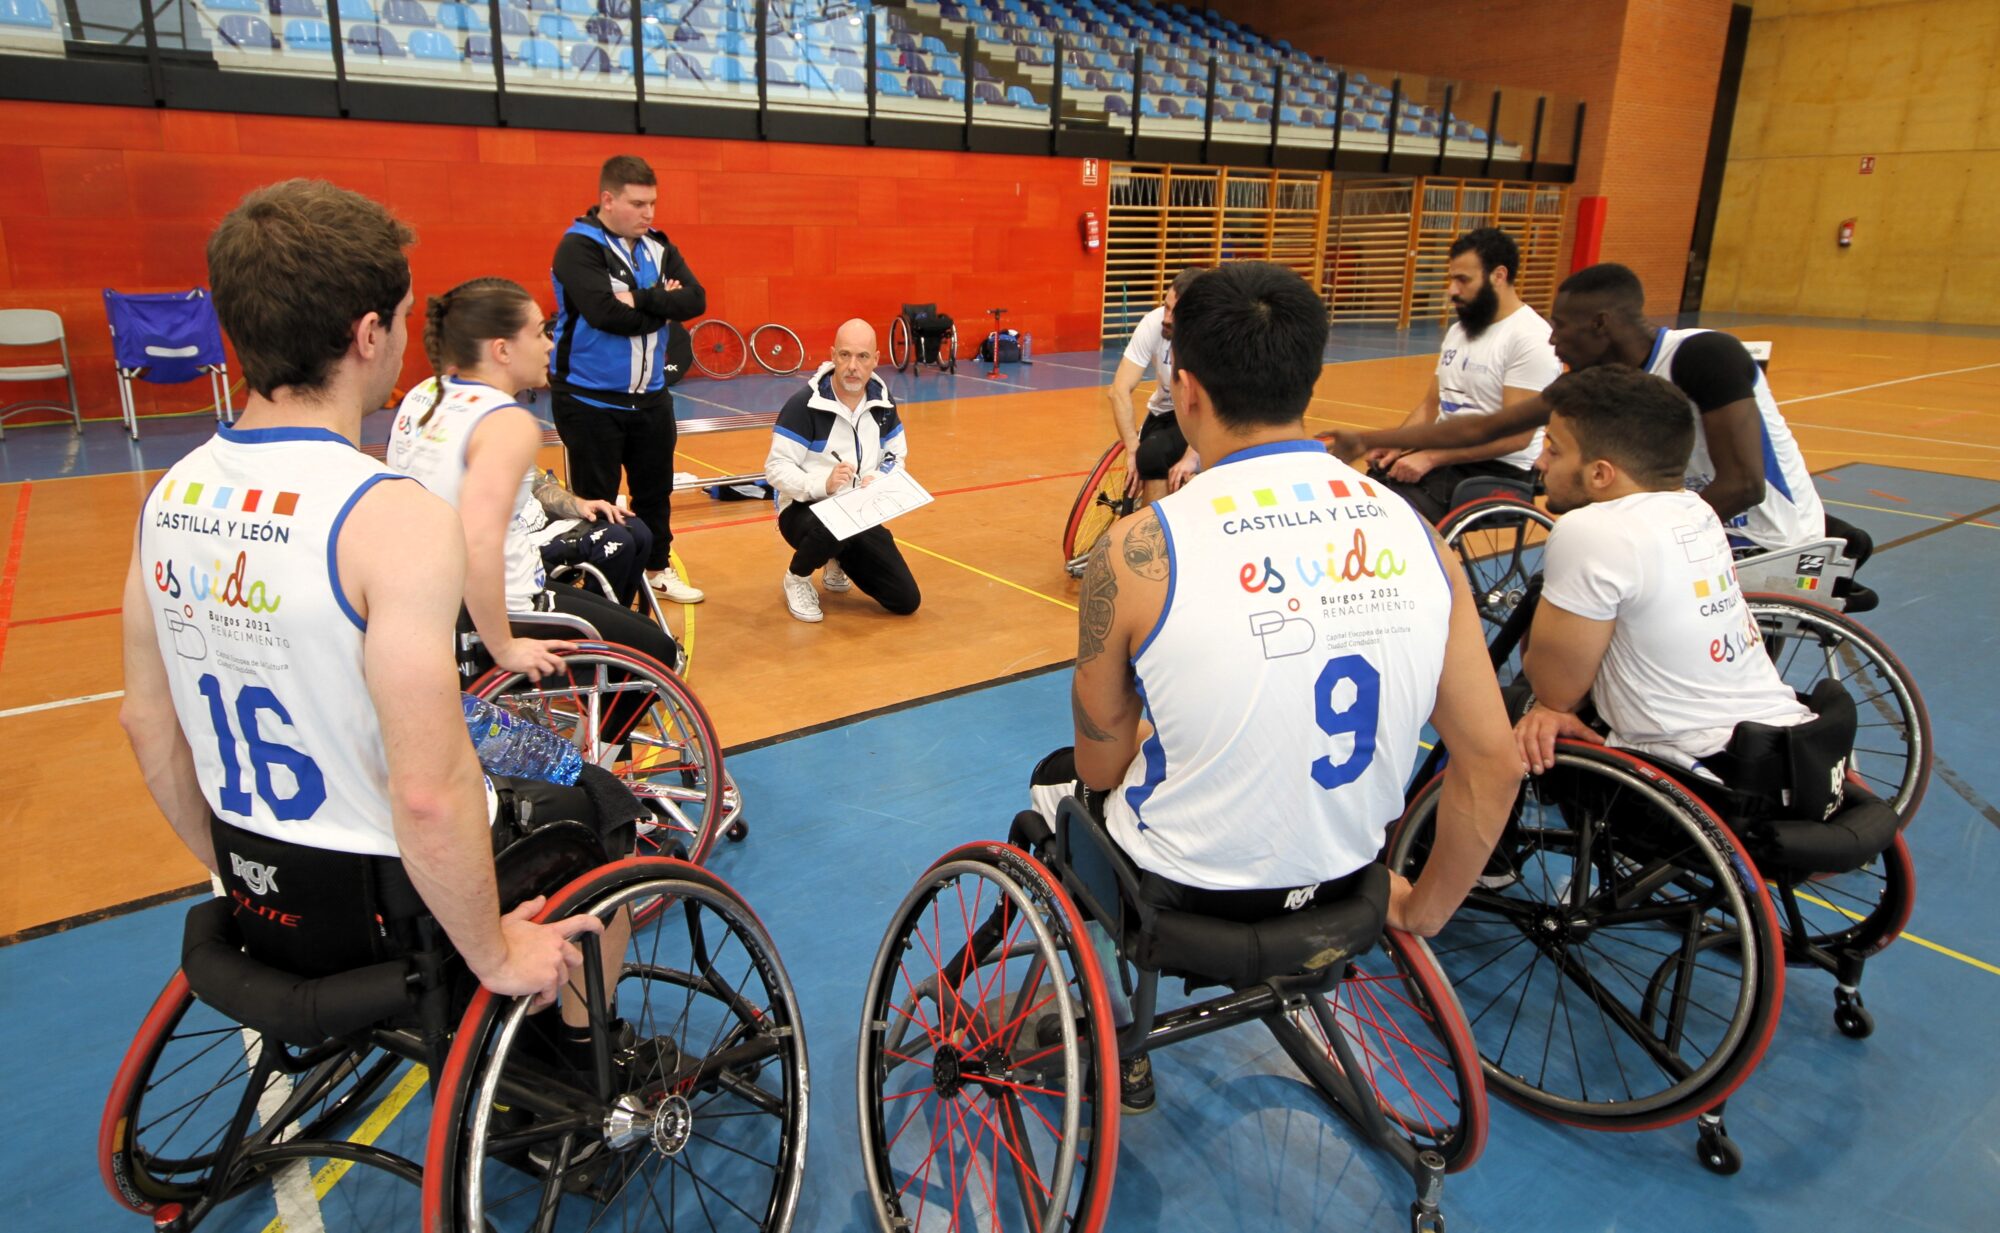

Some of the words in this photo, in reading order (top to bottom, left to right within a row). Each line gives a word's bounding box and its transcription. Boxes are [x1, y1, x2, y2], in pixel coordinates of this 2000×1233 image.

[156, 512, 221, 536] CASTILLA
[227, 521, 237, 537] Y
[241, 520, 289, 544] LEÓN
[1223, 510, 1322, 535] CASTILLA
[1326, 507, 1338, 521] Y
[1345, 501, 1389, 519] LEÓN
[1240, 556, 1286, 594] es
[1296, 528, 1406, 587] vida
[155, 559, 181, 599] es
[190, 550, 281, 613] vida
[1321, 593, 1364, 605] Burgos
[1370, 588, 1399, 599] 2031
[209, 610, 240, 627] Burgos
[246, 618, 271, 632] 2031
[1323, 600, 1415, 619] RENACIMIENTO
[211, 624, 290, 649] RENACIMIENTO
[1710, 633, 1735, 663] es
[1310, 654, 1380, 790] 9
[198, 673, 327, 821] 16
